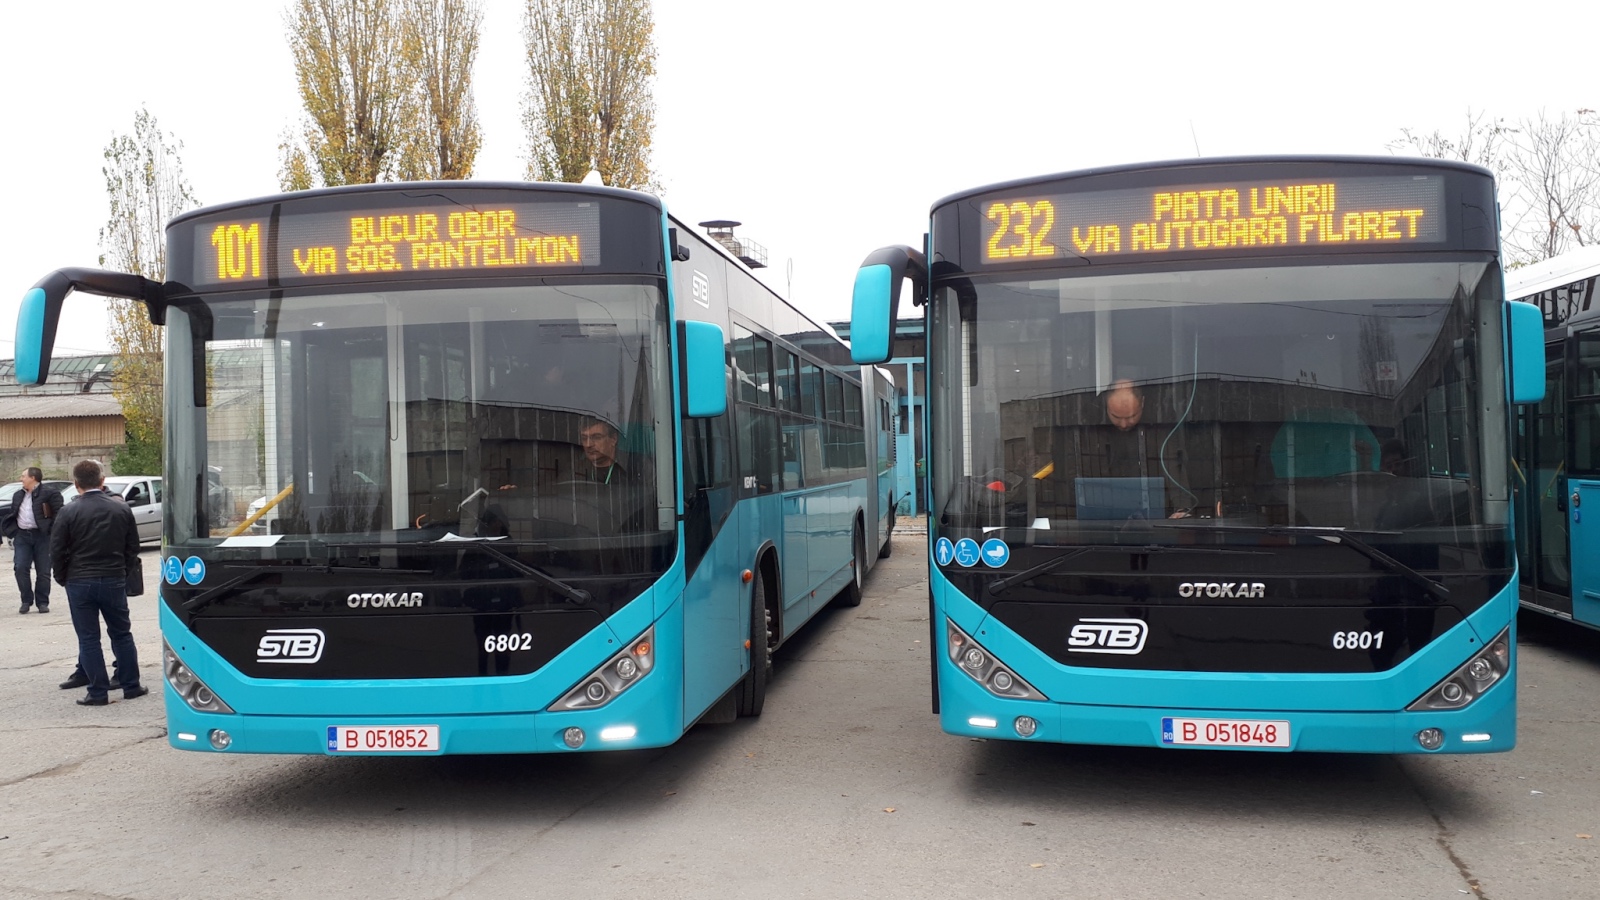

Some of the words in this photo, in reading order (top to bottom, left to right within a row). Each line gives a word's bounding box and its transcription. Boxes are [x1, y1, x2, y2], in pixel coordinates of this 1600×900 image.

[1154, 188, 1239, 221] PIATA
[1250, 183, 1335, 215] UNIRII
[351, 212, 438, 244] BUCUR
[448, 210, 516, 238] OBOR
[987, 200, 1055, 259] 232
[1072, 225, 1121, 254] VIA
[1131, 216, 1288, 250] AUTOGARA
[1299, 209, 1424, 243] FILARET
[211, 223, 261, 279] 101
[293, 247, 336, 274] VIA
[346, 245, 402, 272] SOS.
[412, 235, 579, 269] PANTELIMON
[693, 273, 708, 303] STB
[347, 592, 424, 608] OTOKAR
[1178, 582, 1266, 598] OTOKAR
[257, 633, 320, 659] STB
[484, 632, 532, 653] 6802
[1068, 623, 1142, 649] STB
[1332, 630, 1384, 650] 6801
[346, 730, 359, 748] B
[366, 729, 428, 748] 051852
[1163, 731, 1173, 740] RO
[1182, 722, 1198, 742] B
[1206, 723, 1277, 743] 051848
